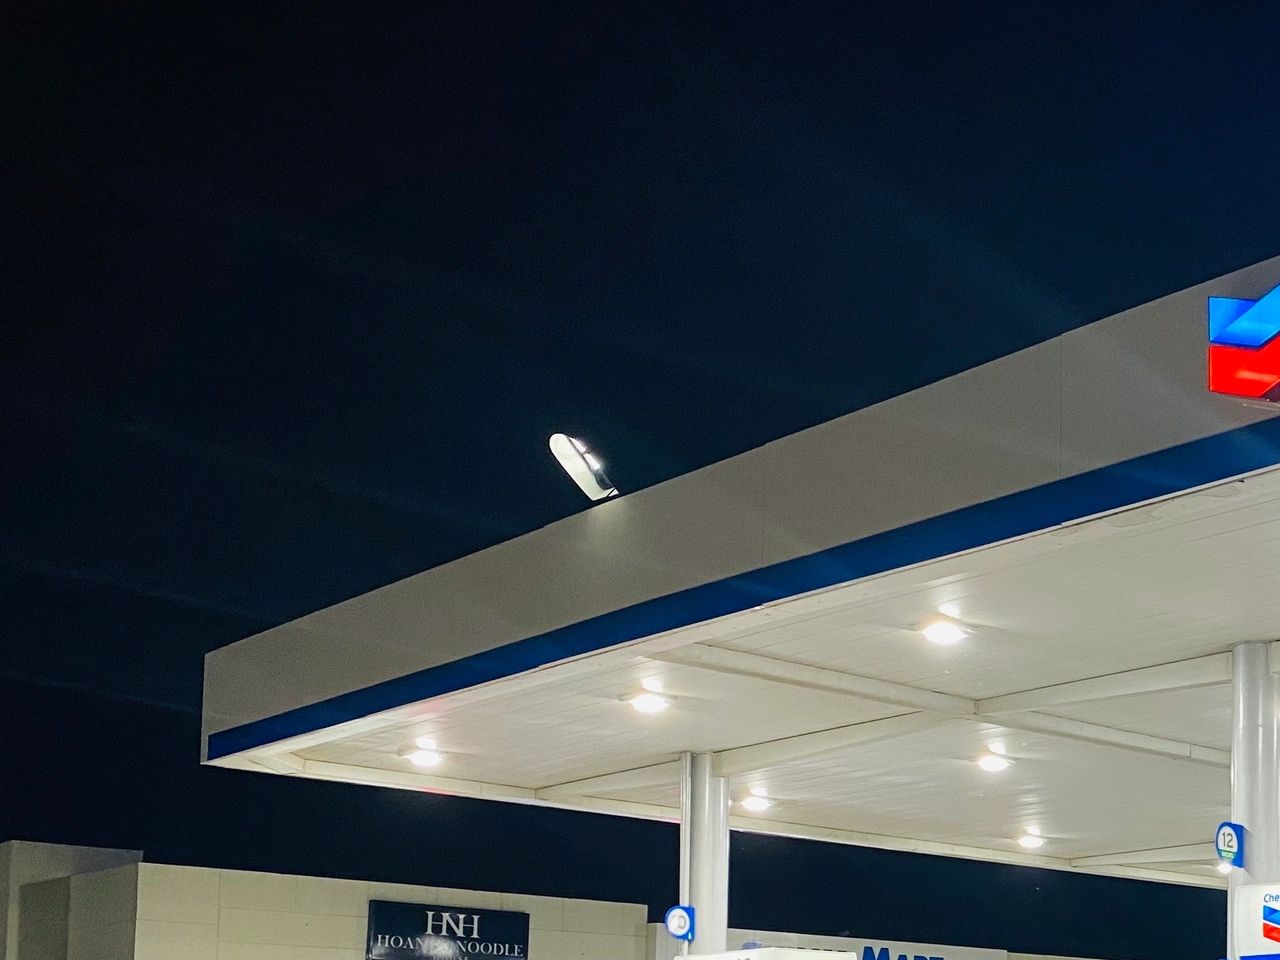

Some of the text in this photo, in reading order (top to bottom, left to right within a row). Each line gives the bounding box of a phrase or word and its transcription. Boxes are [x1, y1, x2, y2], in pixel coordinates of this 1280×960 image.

[1222, 832, 1234, 849] 12
[426, 911, 480, 938] HNH
[457, 940, 524, 957] NOODLE
